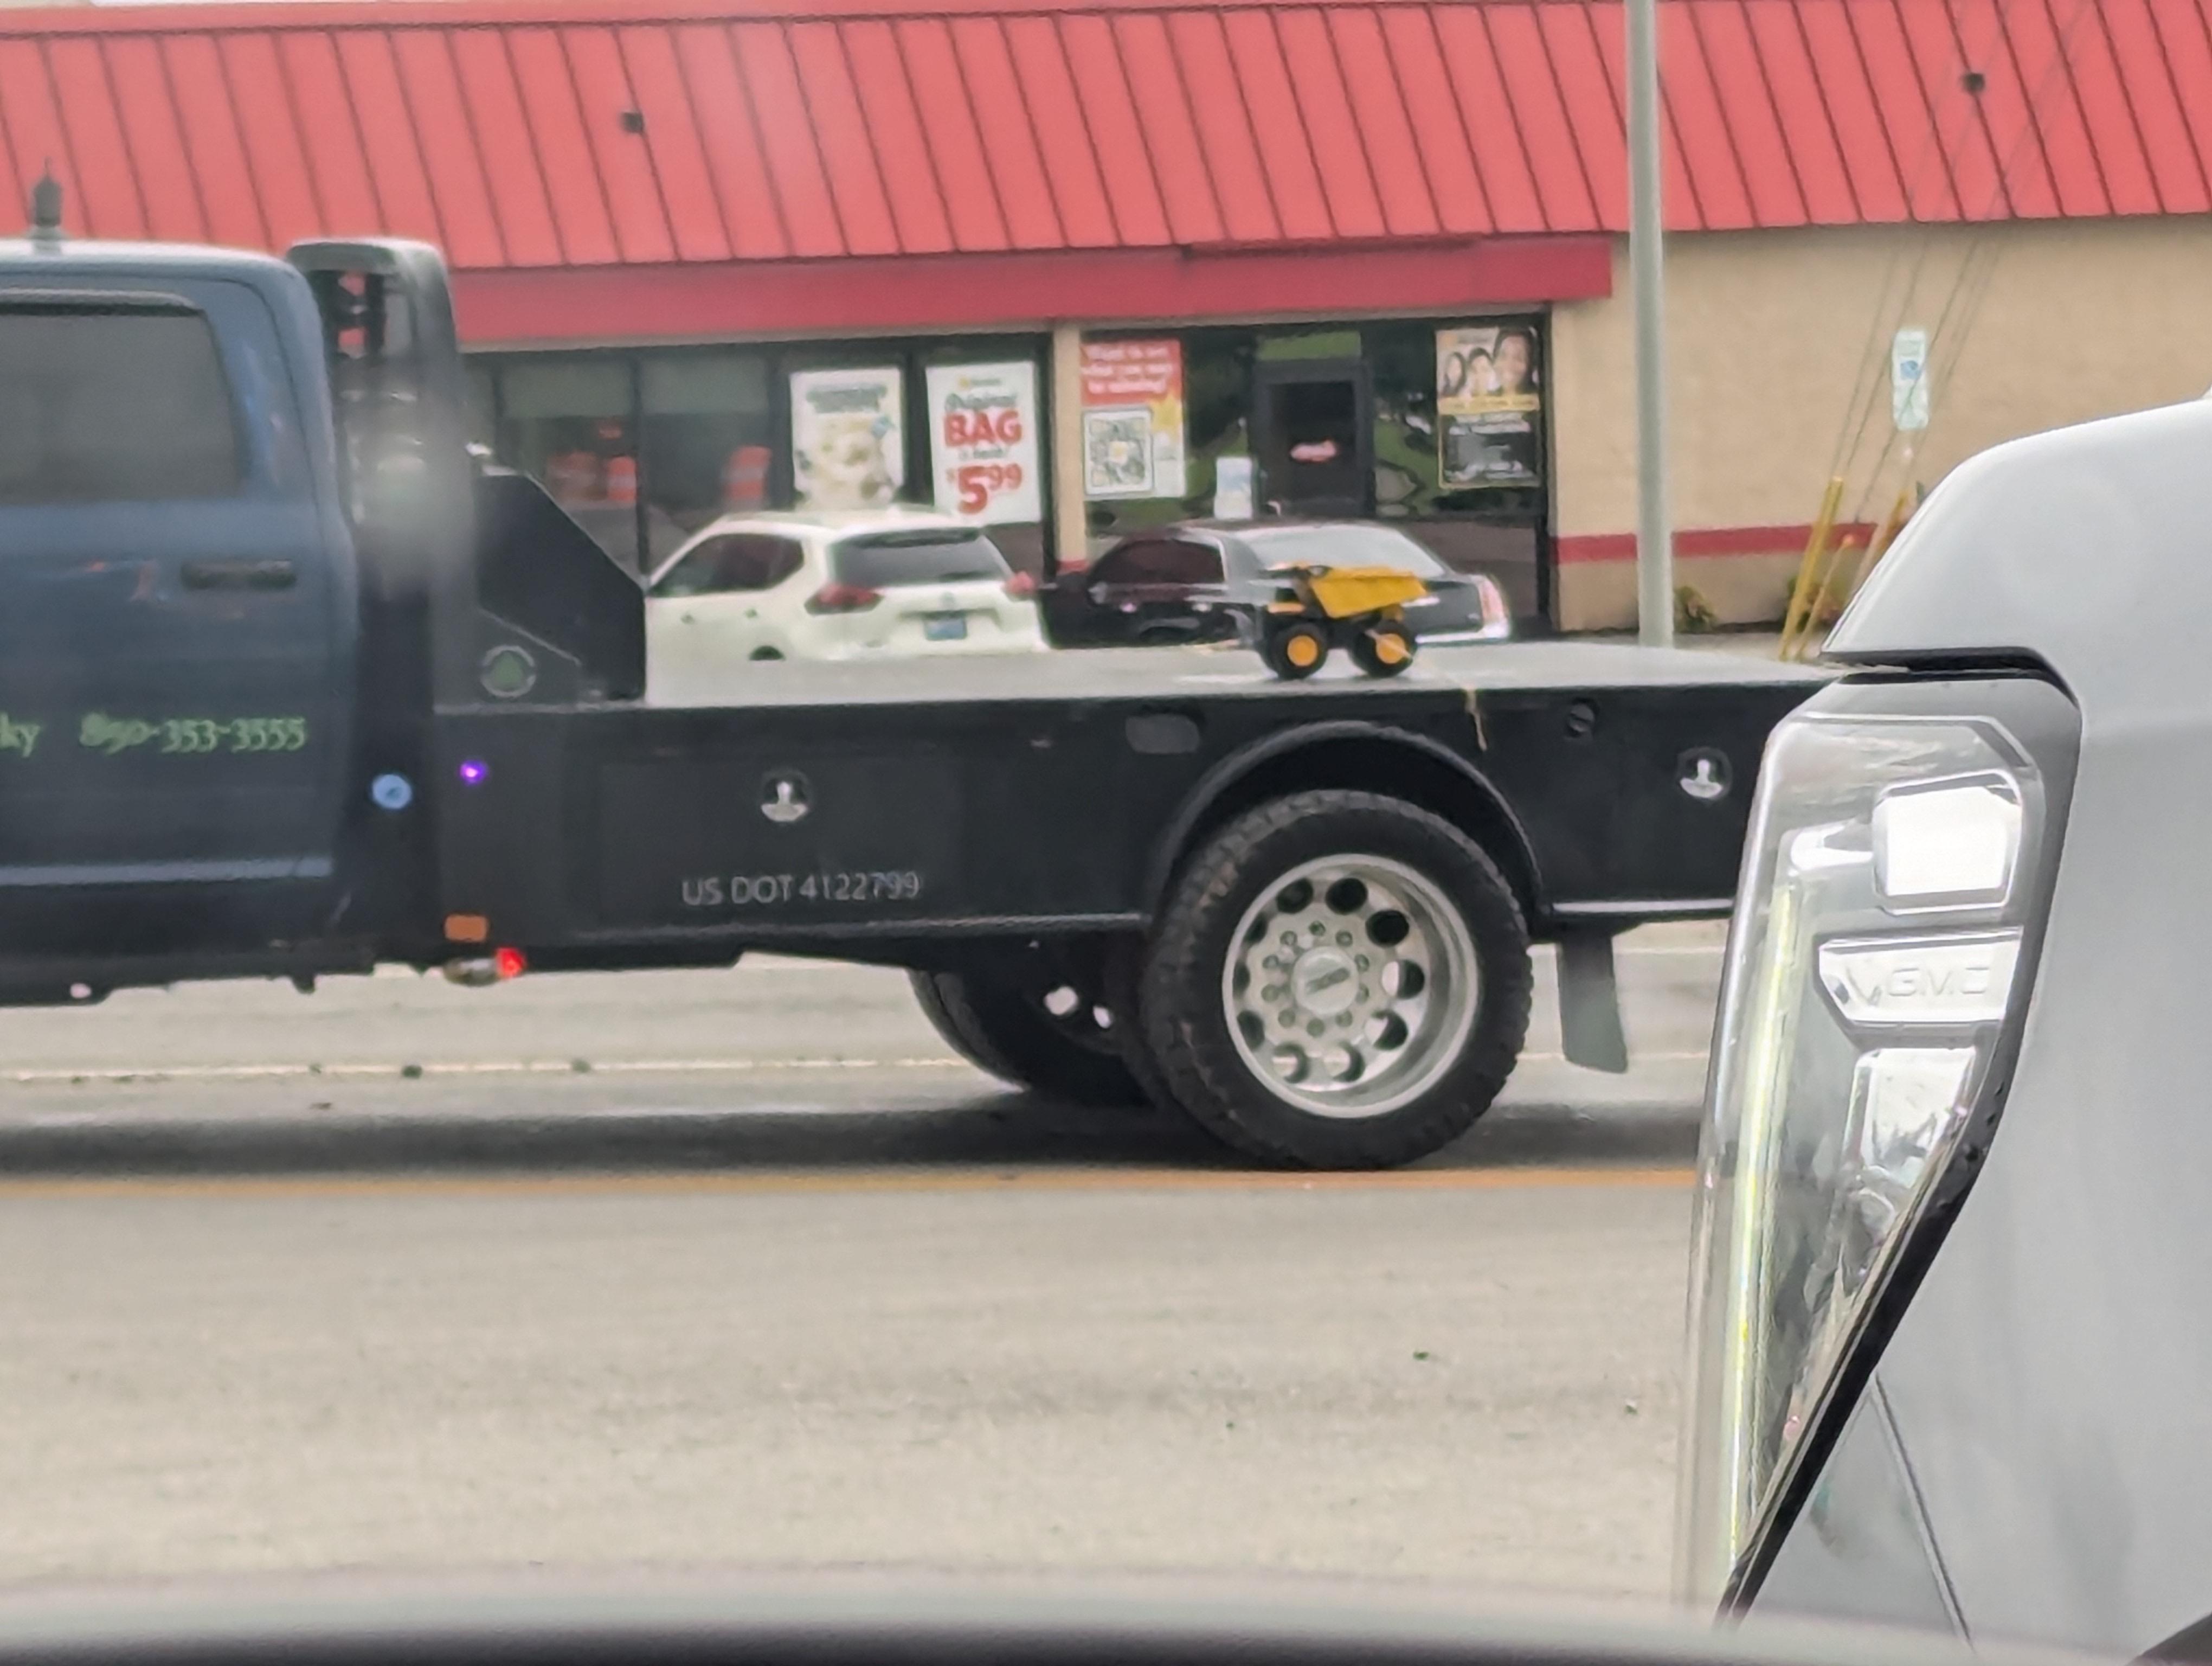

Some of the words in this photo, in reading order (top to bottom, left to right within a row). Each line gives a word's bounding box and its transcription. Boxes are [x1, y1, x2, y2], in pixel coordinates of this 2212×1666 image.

[944, 409, 1023, 447] BAG
[681, 876, 724, 906] US
[731, 874, 794, 905] DOT
[799, 870, 920, 901] 4122799
[1887, 966, 1991, 998] GMC
